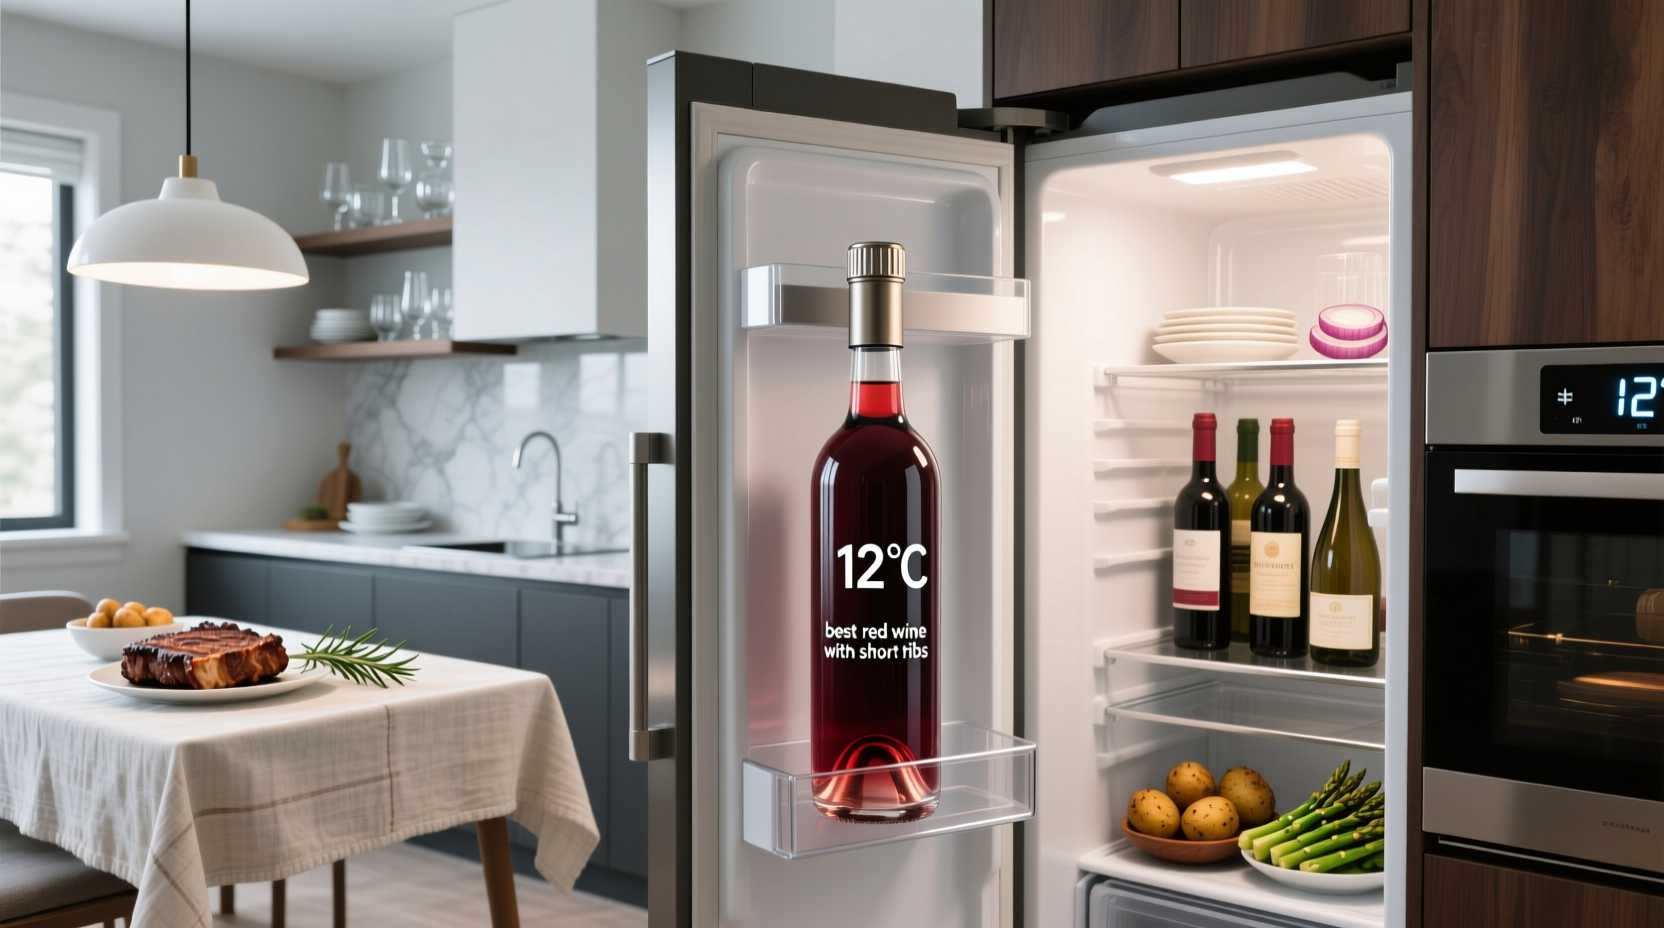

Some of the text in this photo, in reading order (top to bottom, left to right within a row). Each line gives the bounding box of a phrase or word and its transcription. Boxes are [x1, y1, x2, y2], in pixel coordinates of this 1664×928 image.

[837, 543, 928, 589] 12°C
[825, 621, 927, 639] best red wine
[824, 643, 855, 659] with
[859, 642, 898, 659] short
